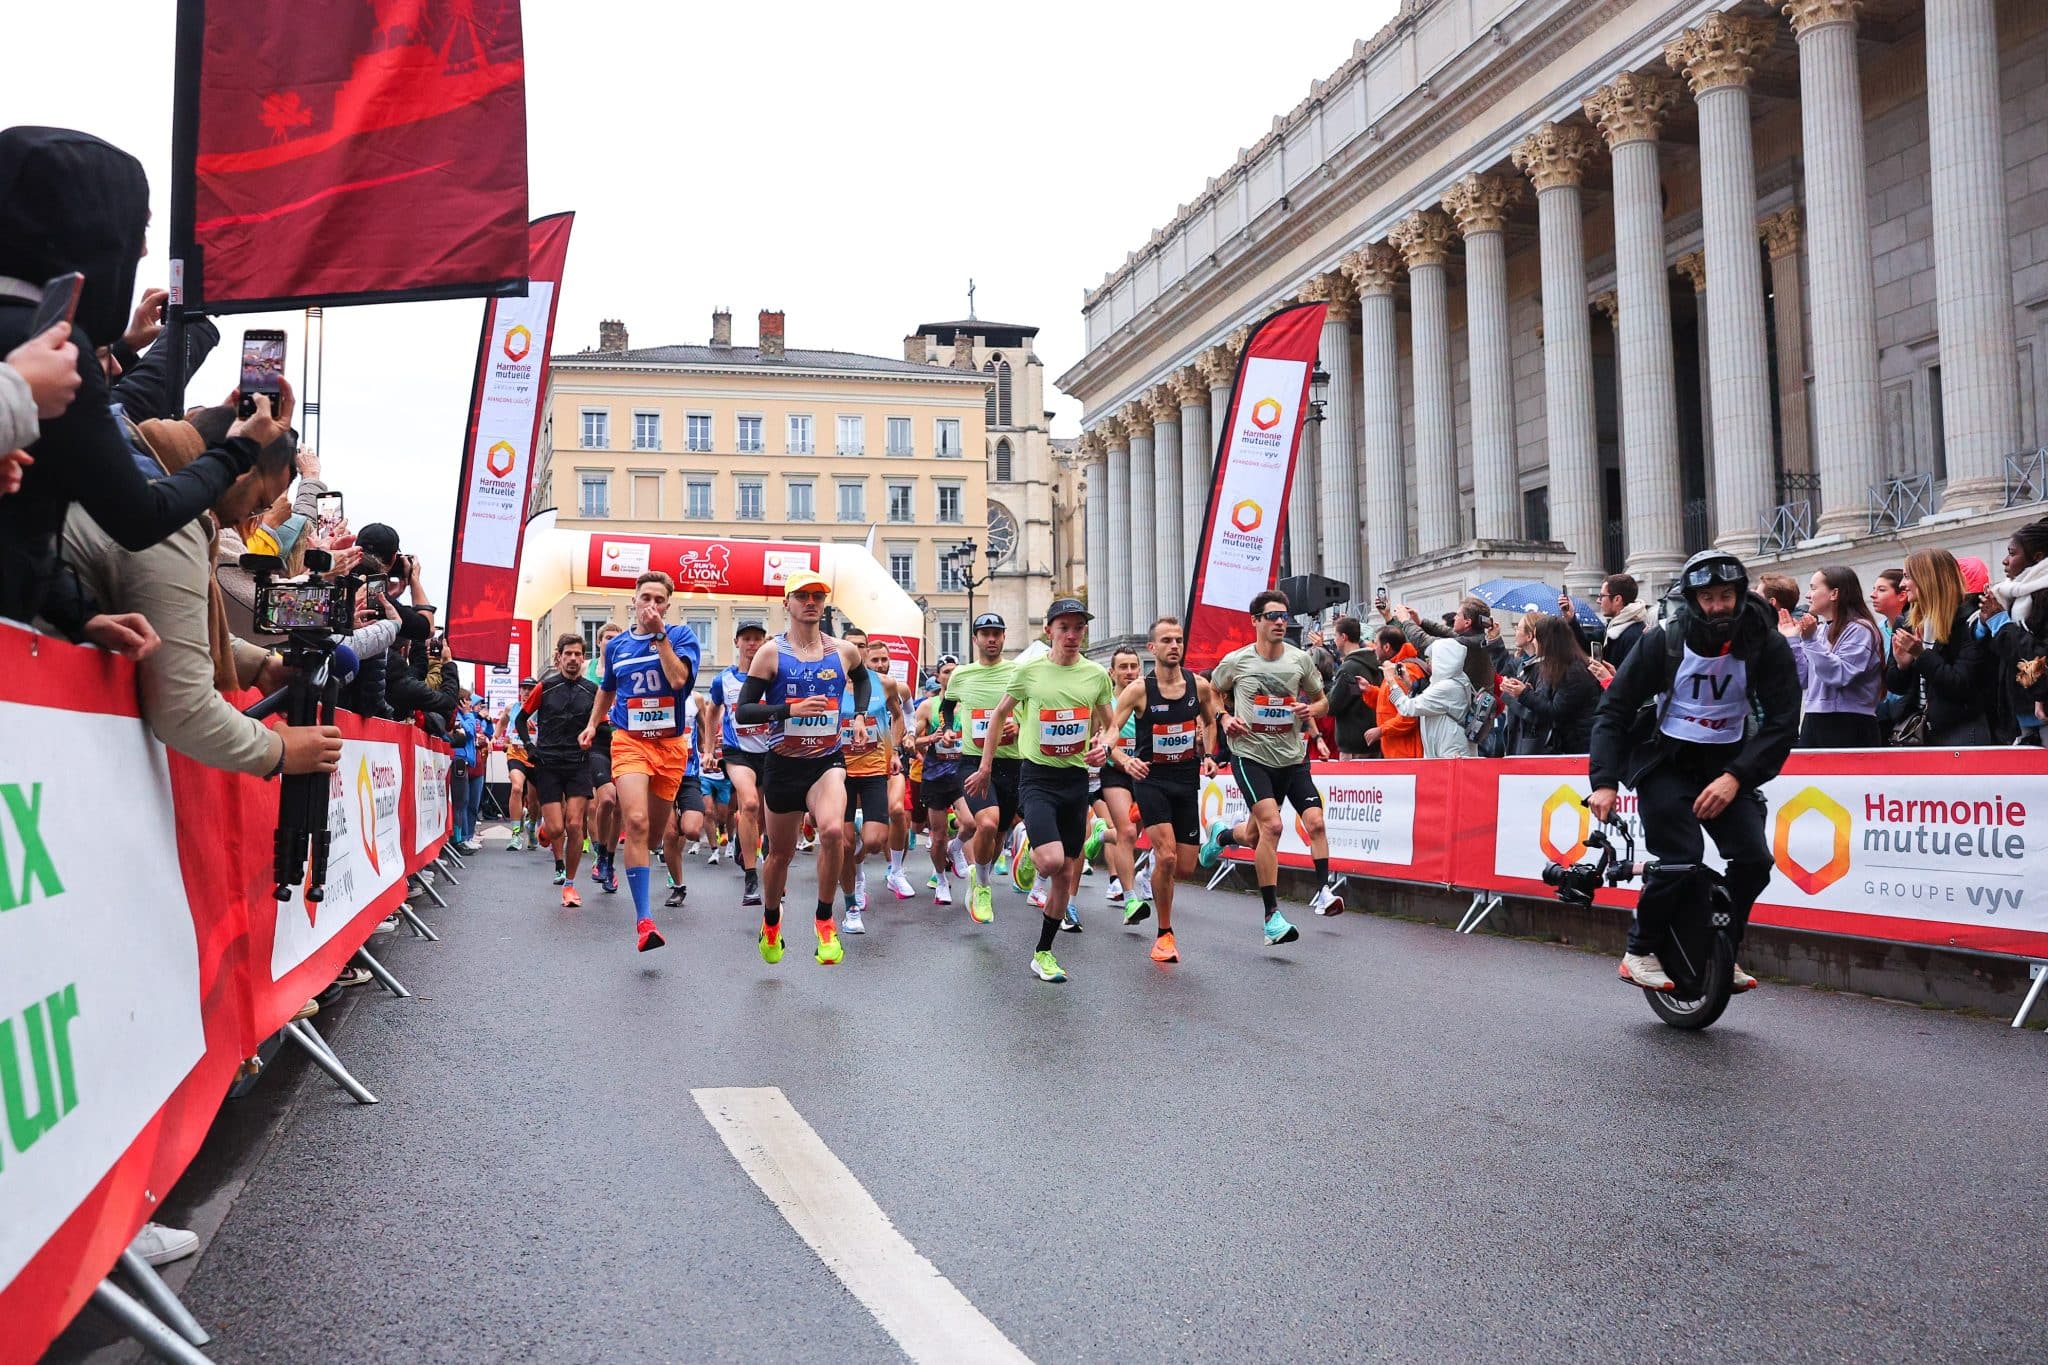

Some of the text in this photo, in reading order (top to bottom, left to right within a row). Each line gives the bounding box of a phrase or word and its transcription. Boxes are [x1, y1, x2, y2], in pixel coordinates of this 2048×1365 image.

[496, 362, 532, 372] Harmonie
[495, 371, 531, 380] mutuelle
[1241, 436, 1281, 447] mutuelle
[1243, 429, 1282, 441] Harmonie
[479, 477, 516, 488] Harmonie
[479, 486, 515, 496] mutuelle
[1223, 530, 1264, 543] Harmonie
[1222, 538, 1263, 551] mutuelle
[687, 568, 721, 580] LYON
[630, 669, 661, 695] 20
[1689, 673, 1733, 700] TV
[638, 710, 664, 722] 7022
[1264, 708, 1286, 718] 7021
[798, 714, 828, 727] 7070
[1051, 724, 1080, 737] 7087
[801, 737, 817, 745] 21K
[1161, 735, 1188, 747] 7098
[1329, 786, 1383, 804] Harmonie
[1328, 804, 1382, 822] mutuelle
[1864, 793, 2027, 827] Harmonie
[1361, 838, 1380, 854] vyv
[1863, 825, 2025, 859] mutuelle
[1864, 881, 2024, 915] GROUPE vyv
